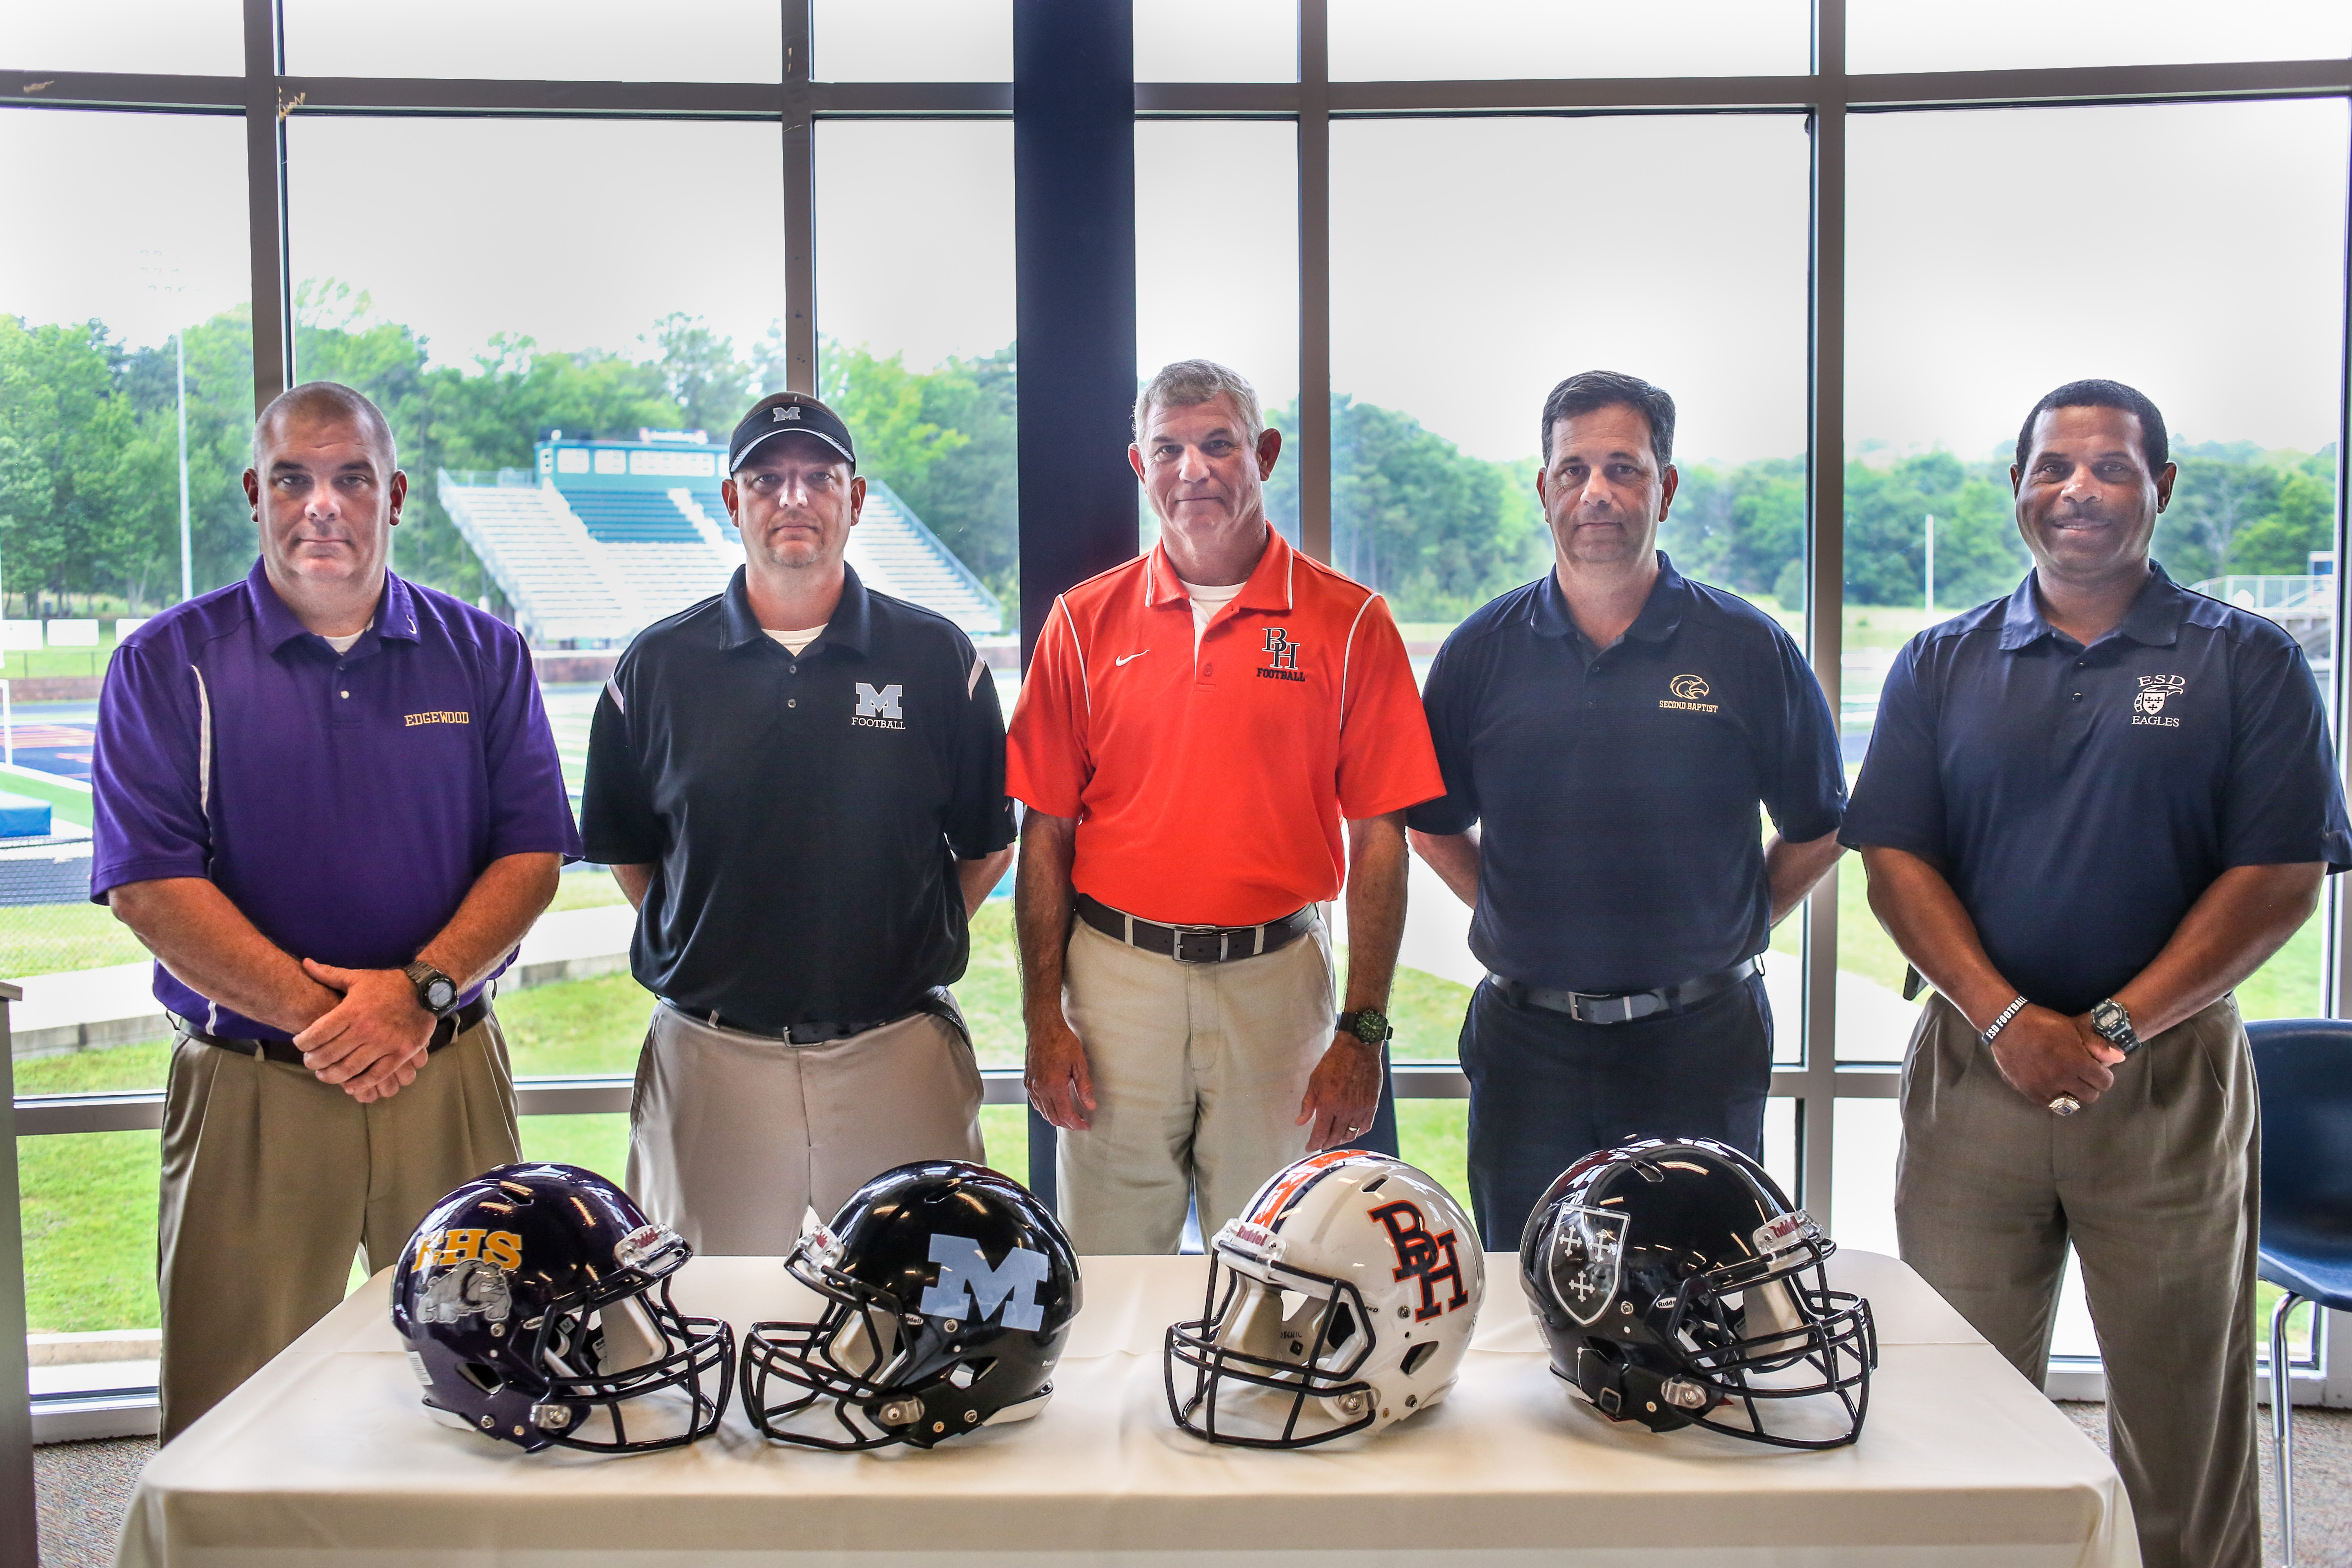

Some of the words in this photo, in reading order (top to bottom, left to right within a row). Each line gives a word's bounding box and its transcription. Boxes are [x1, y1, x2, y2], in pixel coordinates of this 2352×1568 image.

[773, 406, 801, 423] M
[1262, 627, 1301, 670] BH
[1256, 668, 1305, 682] FOOTBALL
[2137, 675, 2186, 687] ESD
[855, 682, 902, 719] M
[1659, 700, 1686, 709] SECOND
[1687, 702, 1718, 713] BAPTIST
[404, 711, 469, 726] EDGEWOOD
[851, 717, 906, 729] FOOTBALL
[2132, 715, 2180, 727] EAGLES
[1986, 1024, 2000, 1039] ESD
[1996, 996, 2028, 1027] FOOTBALL
[411, 1228, 523, 1274] EHS
[1367, 1200, 1468, 1323] BH
[919, 1233, 1049, 1332] M
